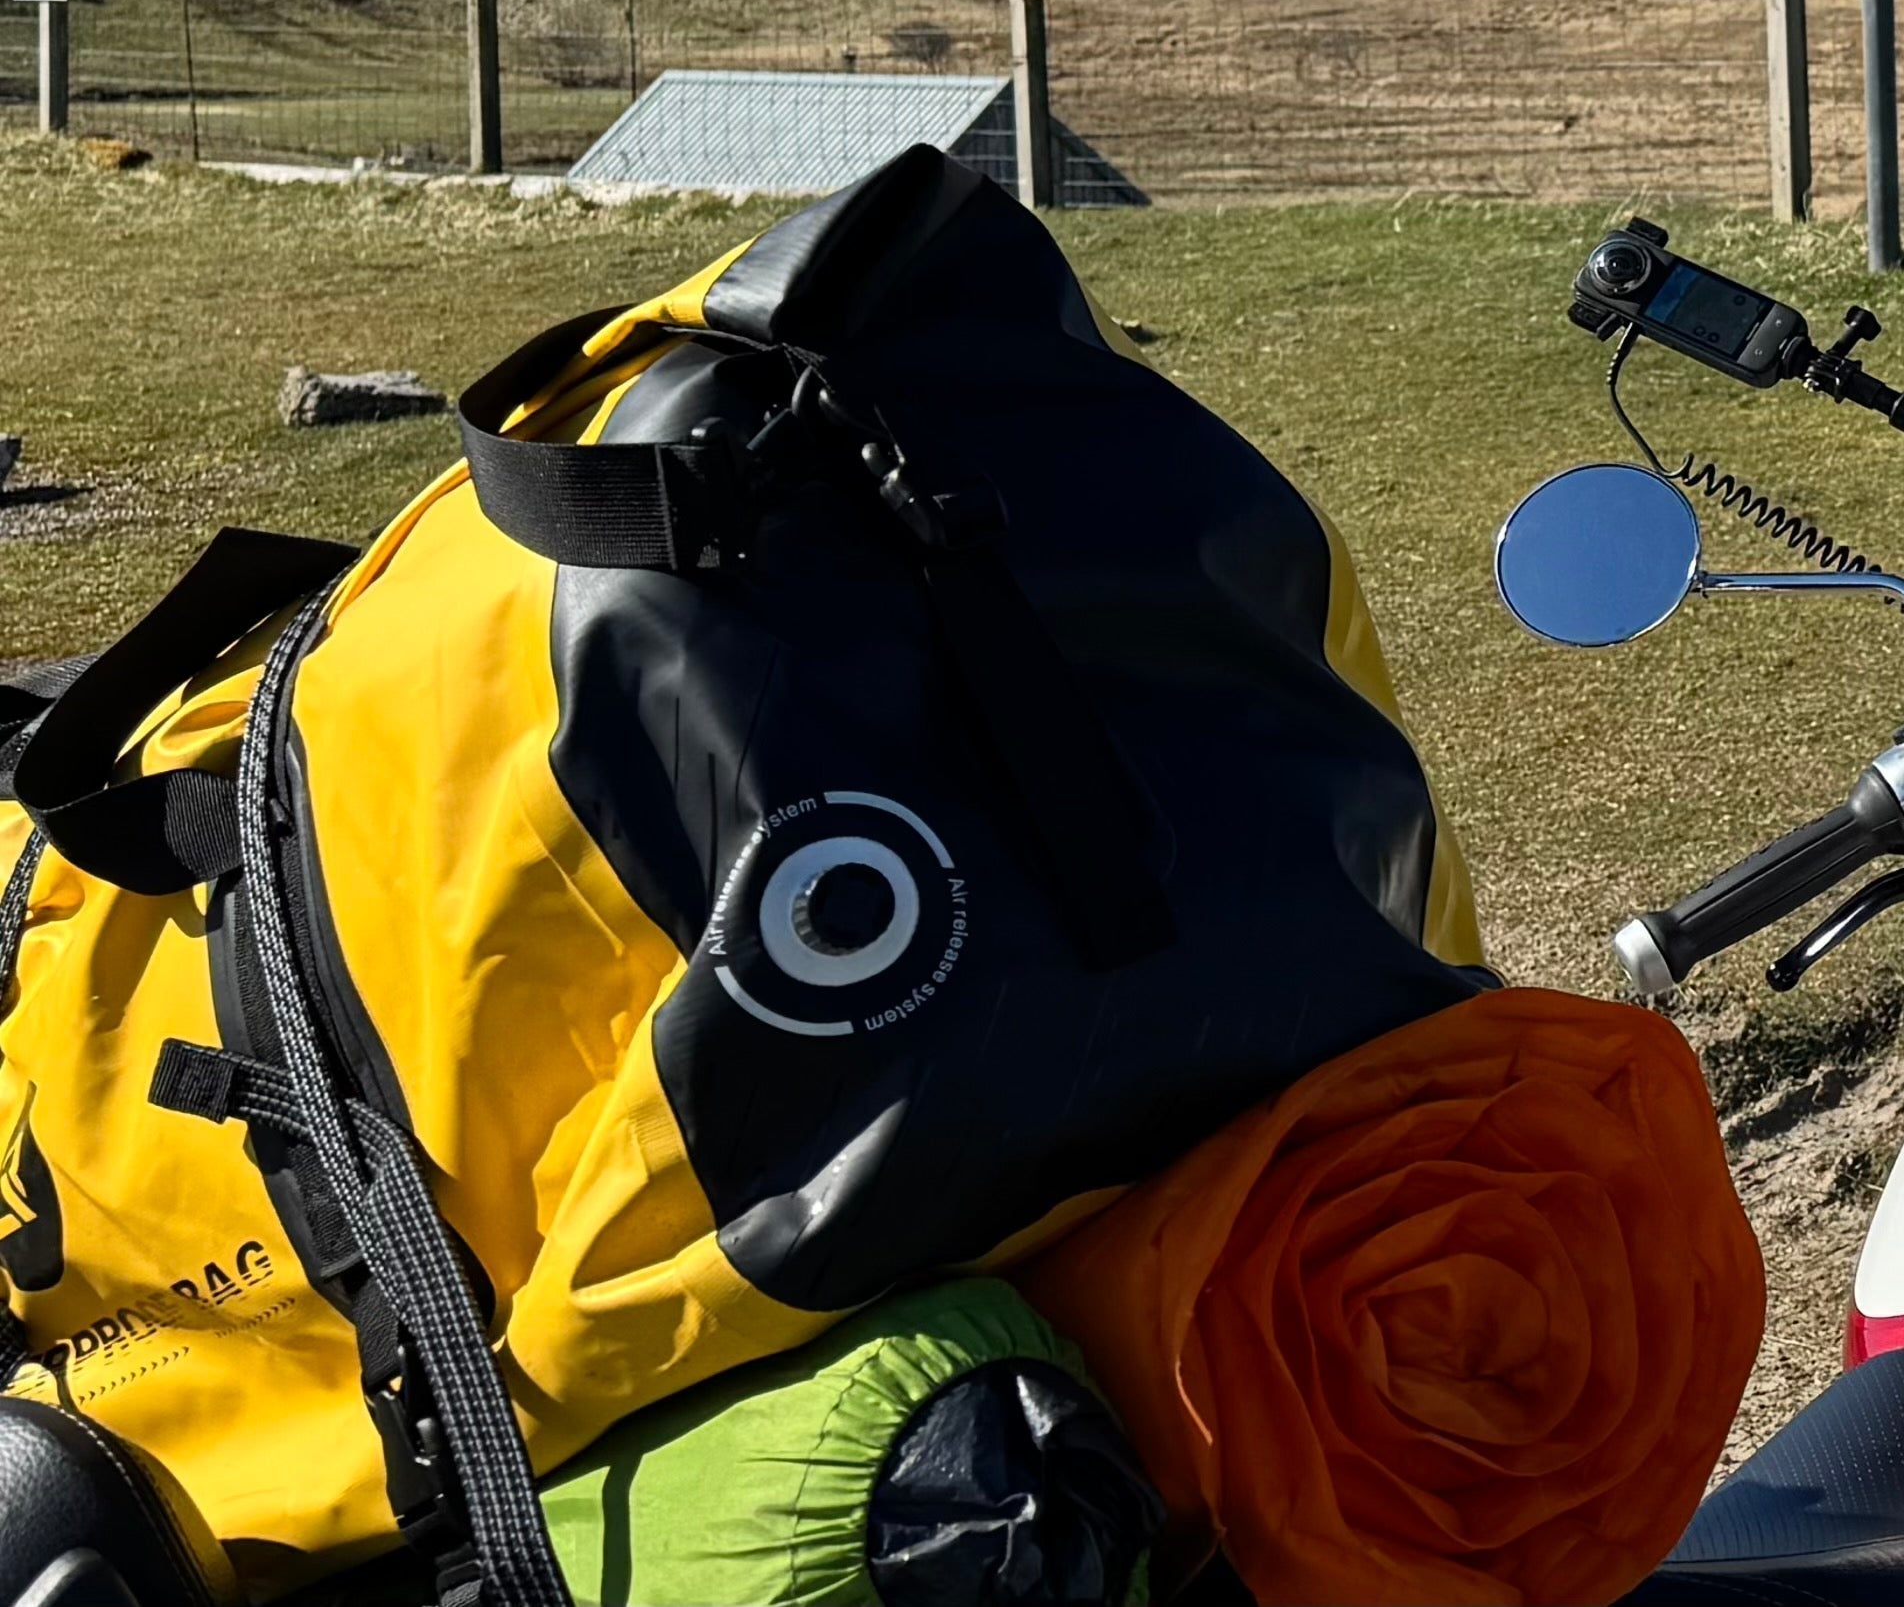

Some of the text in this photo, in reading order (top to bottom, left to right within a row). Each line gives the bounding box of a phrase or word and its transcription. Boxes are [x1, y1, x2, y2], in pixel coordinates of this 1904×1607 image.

[864, 878, 969, 1031] Air release system
[170, 1240, 274, 1309] BAG
